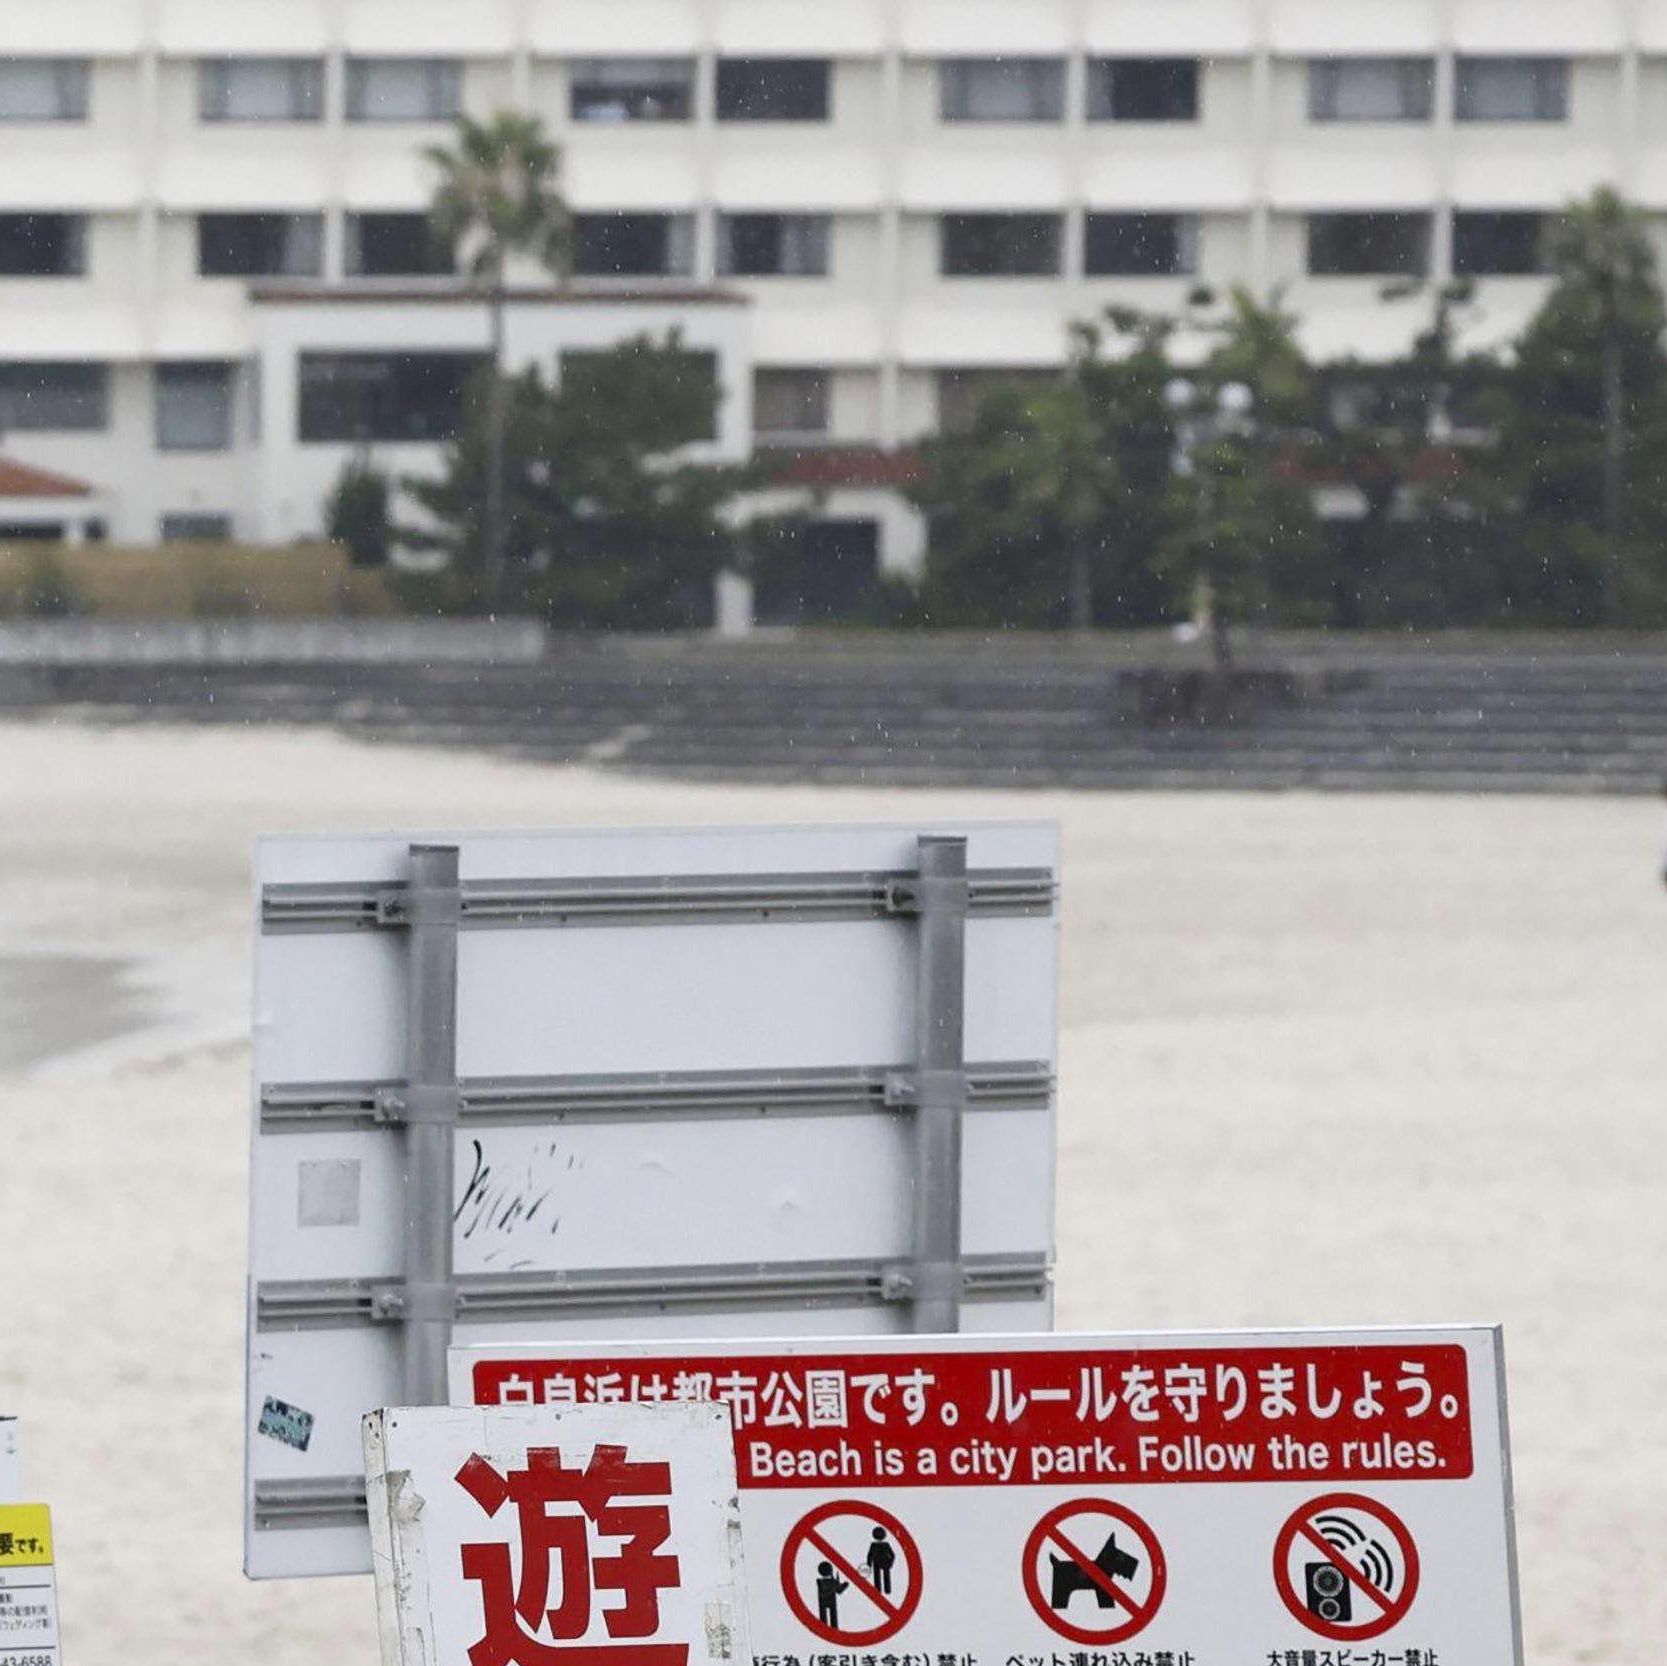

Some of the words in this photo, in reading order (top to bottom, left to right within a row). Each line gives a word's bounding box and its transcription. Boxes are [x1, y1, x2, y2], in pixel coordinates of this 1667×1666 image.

[750, 1440, 859, 1477] Beach
[874, 1440, 904, 1475] is
[917, 1448, 937, 1474] a
[950, 1439, 1017, 1481] city
[1031, 1437, 1126, 1480] park.
[1139, 1436, 1255, 1472] Follow
[1267, 1434, 1329, 1470] the
[1343, 1434, 1445, 1468] rules.
